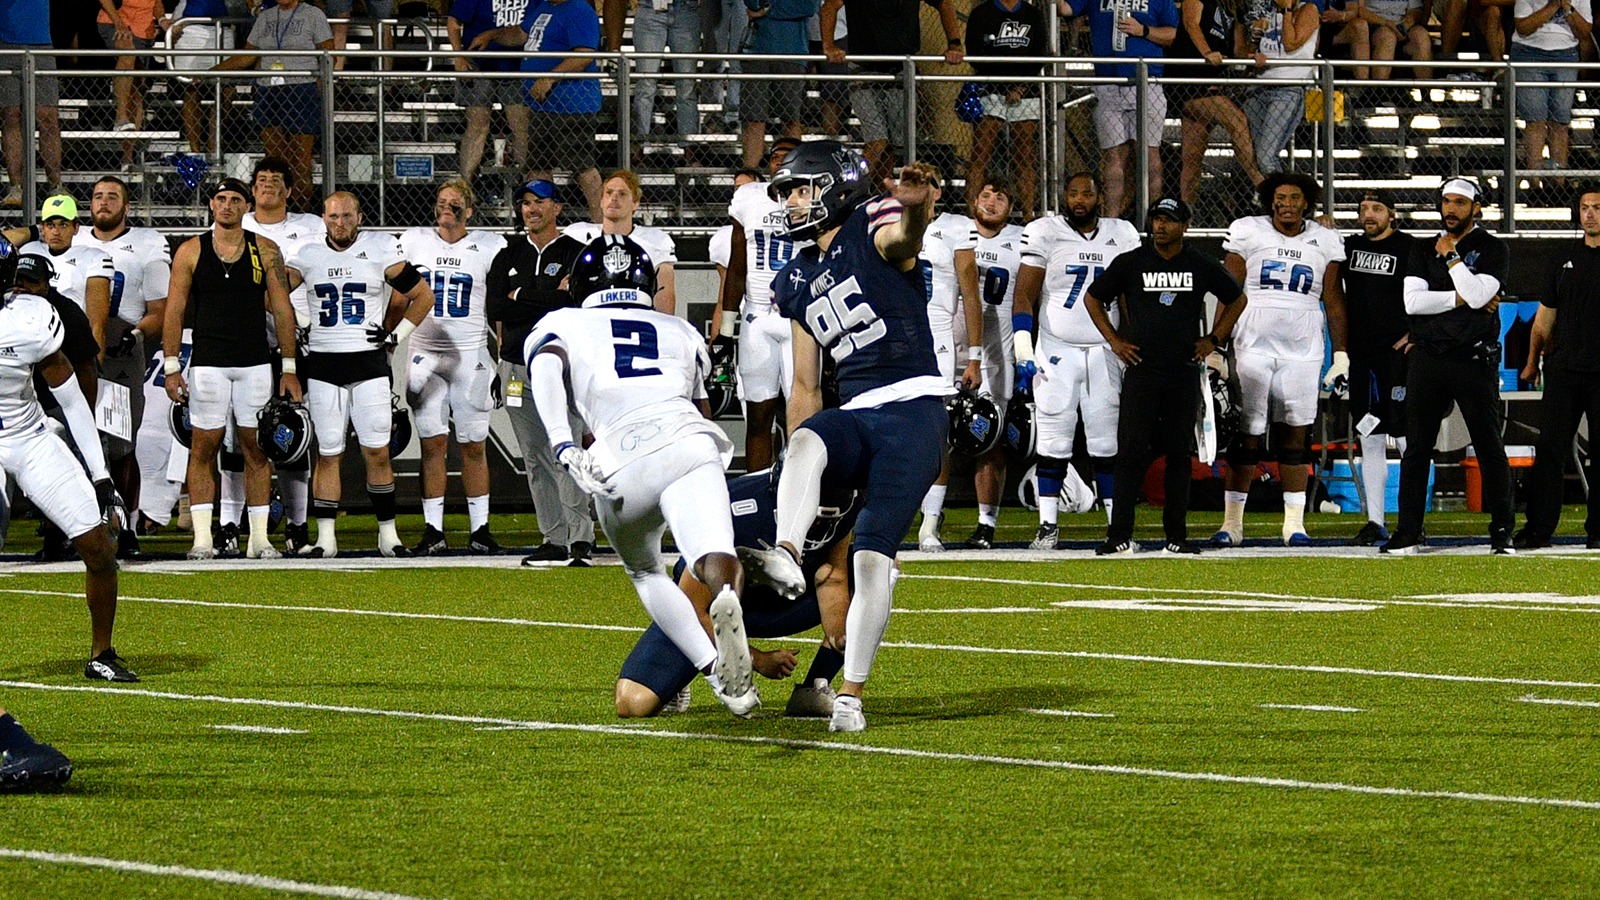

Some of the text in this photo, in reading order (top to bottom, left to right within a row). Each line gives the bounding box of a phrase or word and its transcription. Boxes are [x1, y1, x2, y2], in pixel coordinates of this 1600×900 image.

[492, 0, 529, 12] BLEED
[496, 9, 526, 27] BLUE
[762, 215, 783, 225] GVS
[436, 256, 462, 267] GVSU
[1079, 252, 1103, 262] GVSU
[1278, 248, 1302, 259] GVSU
[1355, 252, 1391, 270] WAWG
[810, 268, 836, 299] MINES
[1142, 271, 1193, 288] WAWG
[1261, 259, 1314, 295] 50
[1063, 264, 1104, 310] 7
[314, 282, 367, 327] 36
[600, 290, 638, 303] LAKERS
[805, 275, 887, 363] 95
[610, 318, 664, 379] 2
